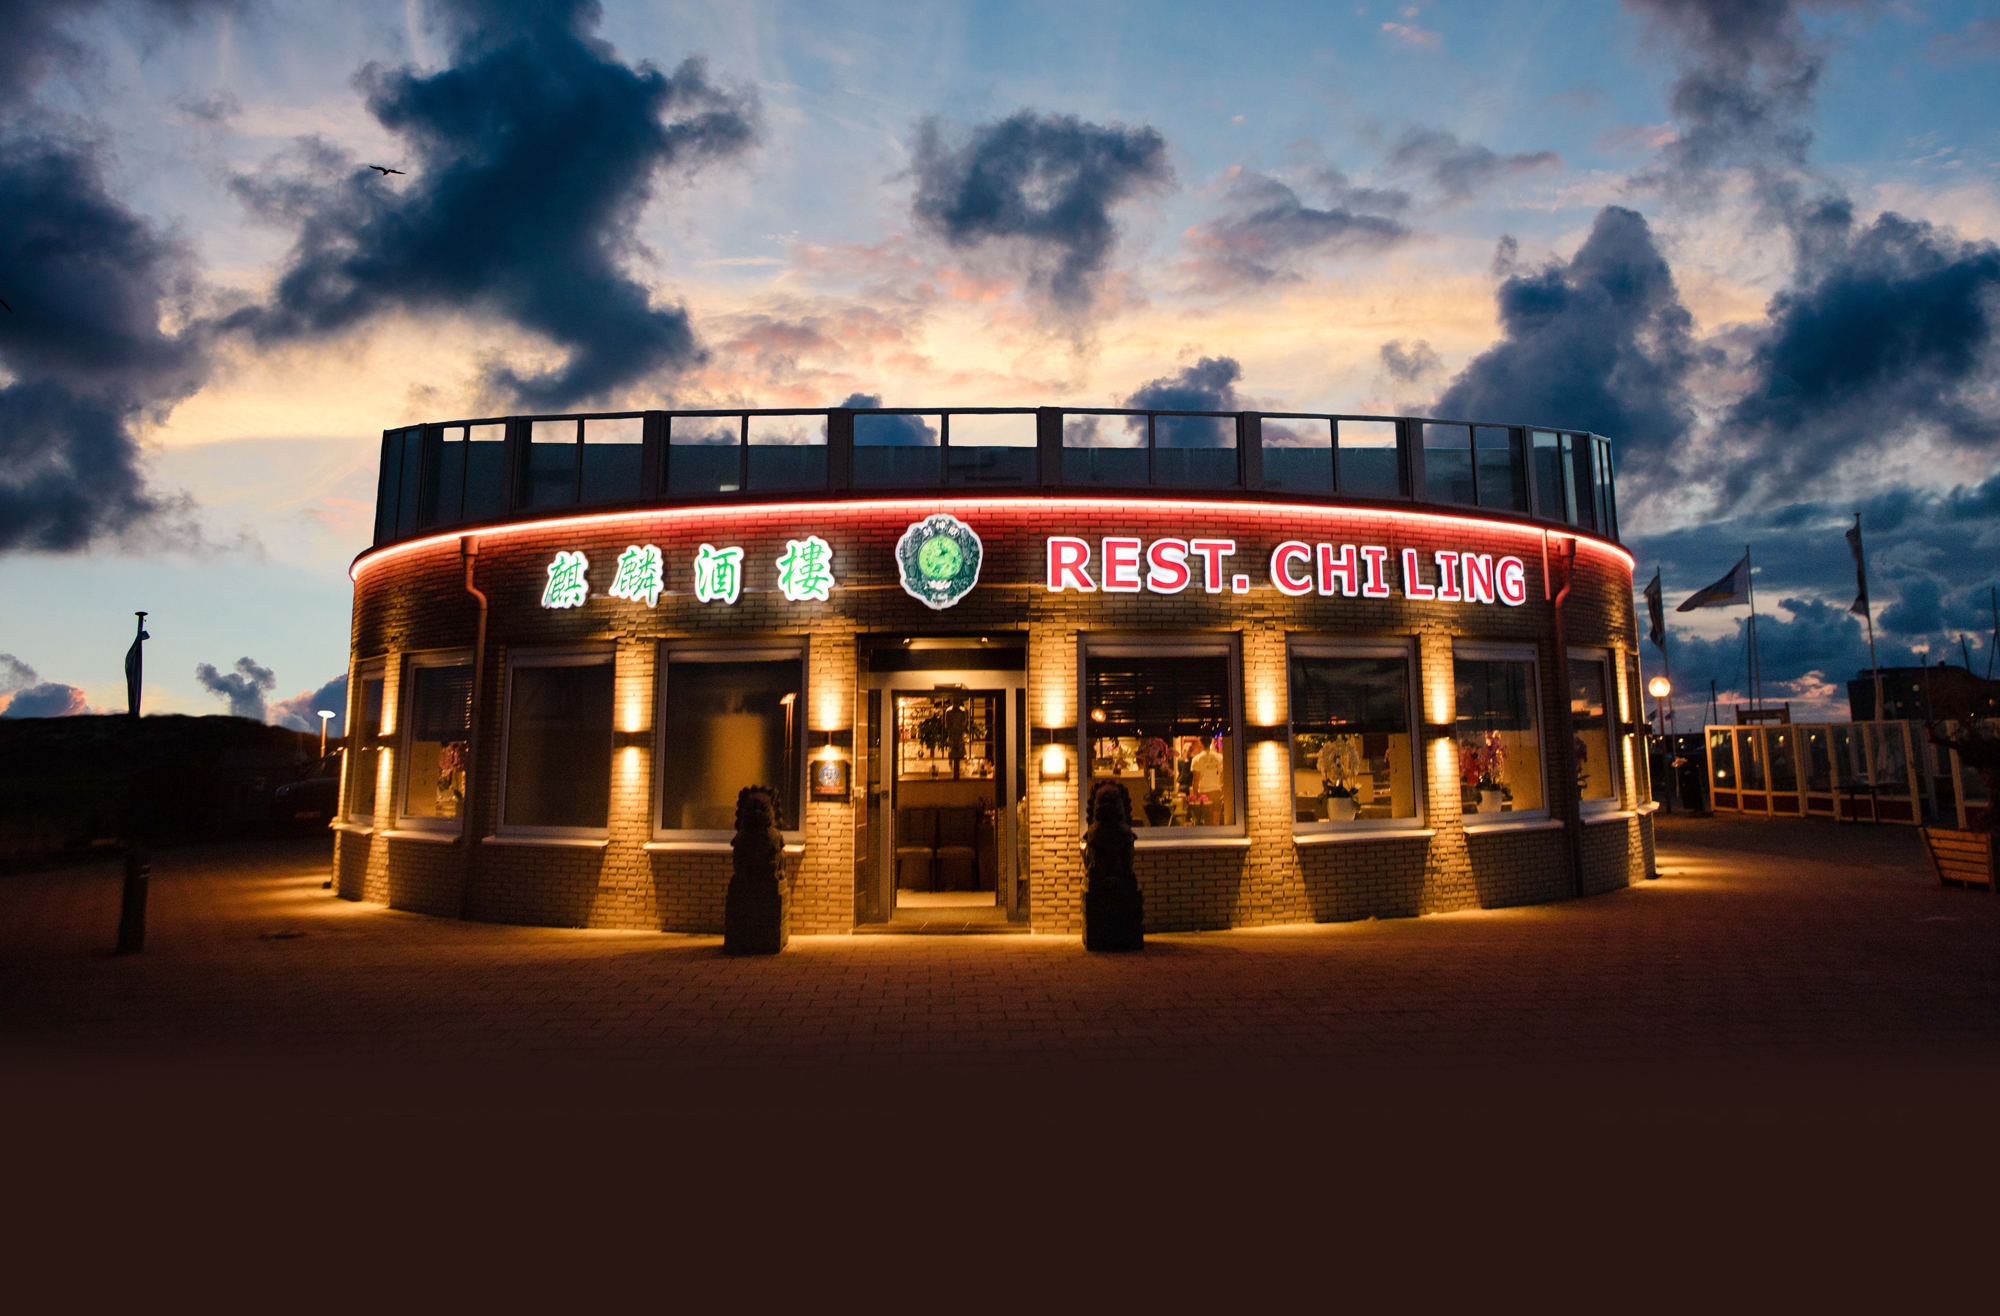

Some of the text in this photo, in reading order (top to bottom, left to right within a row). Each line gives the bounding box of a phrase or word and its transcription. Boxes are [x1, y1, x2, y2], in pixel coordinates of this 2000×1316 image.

[543, 538, 832, 606] 麒麟酒樓
[1048, 538, 1525, 604] REST. CHI LING
